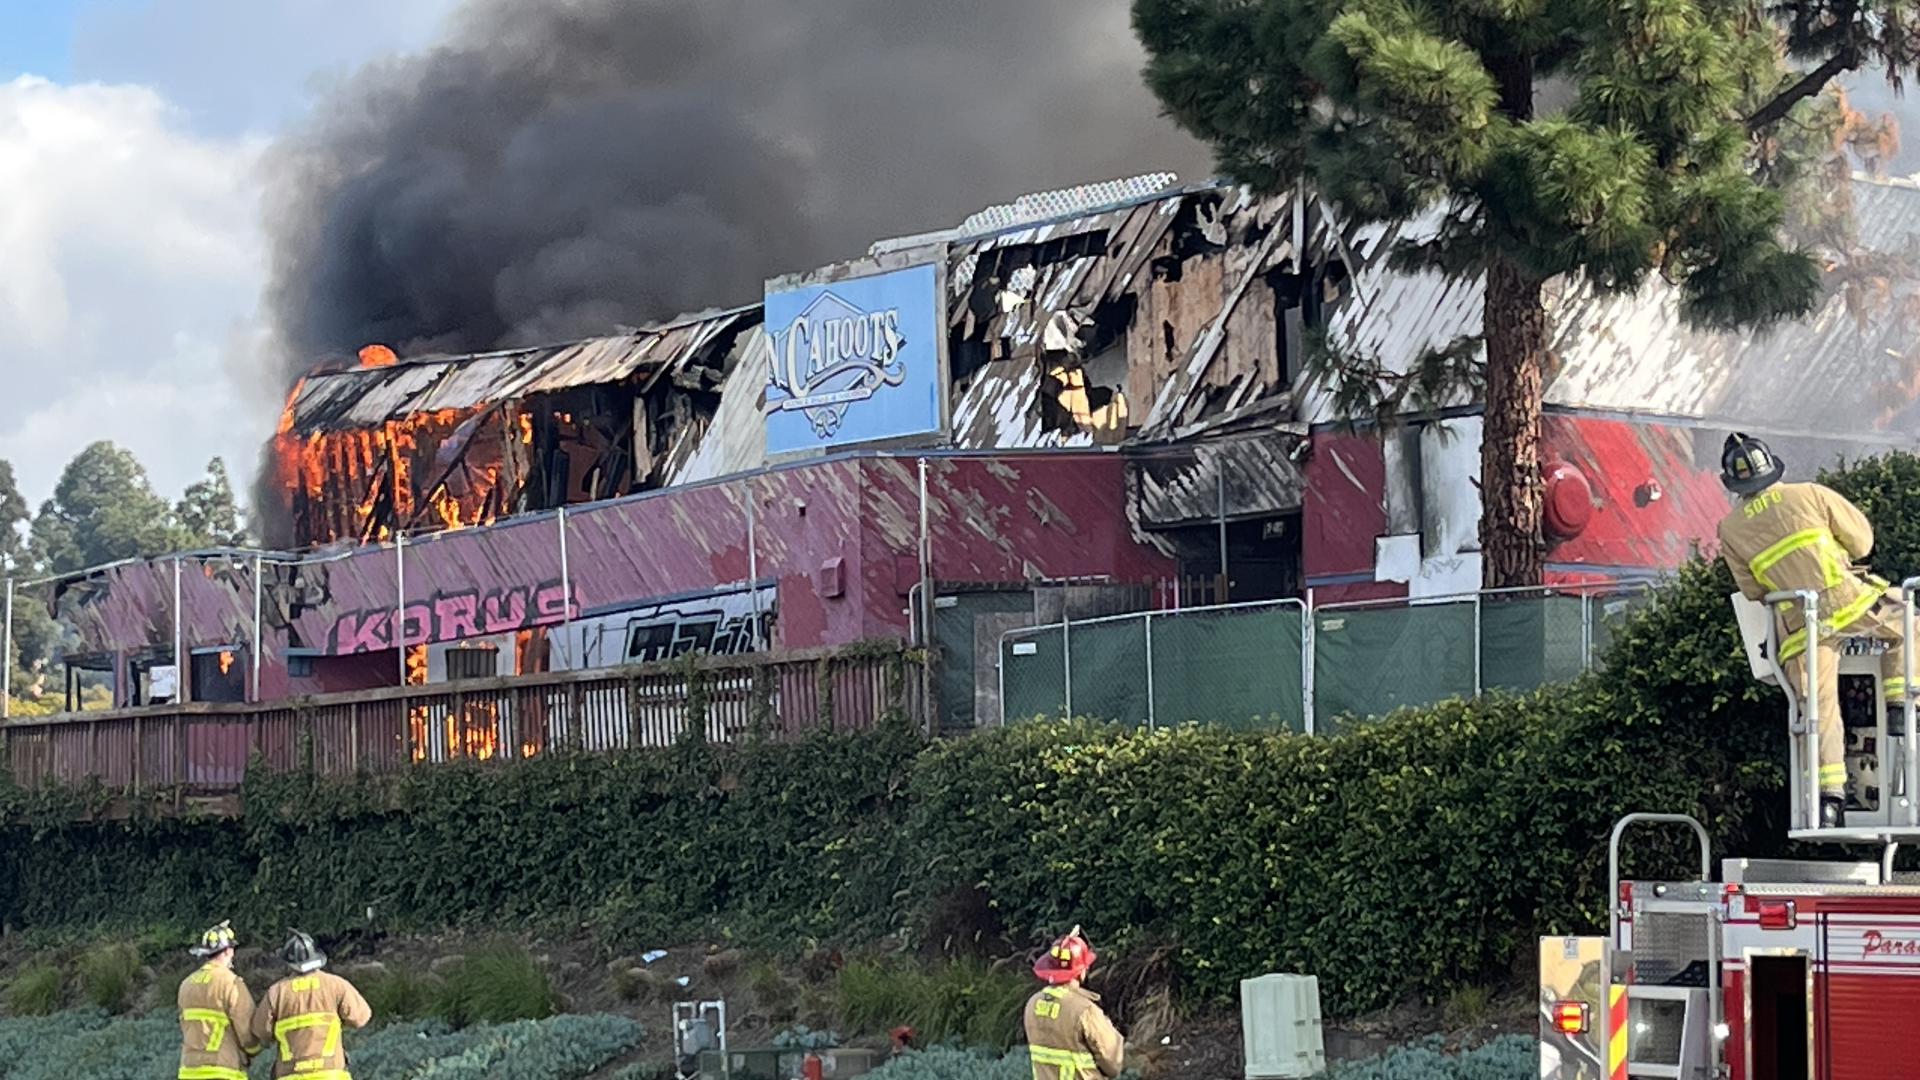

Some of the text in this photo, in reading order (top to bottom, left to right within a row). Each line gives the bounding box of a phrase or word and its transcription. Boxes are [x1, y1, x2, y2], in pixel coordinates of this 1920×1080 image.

[786, 308, 899, 399] CAHOOTS
[326, 579, 579, 656] KORUS
[1862, 929, 1920, 960] Para
